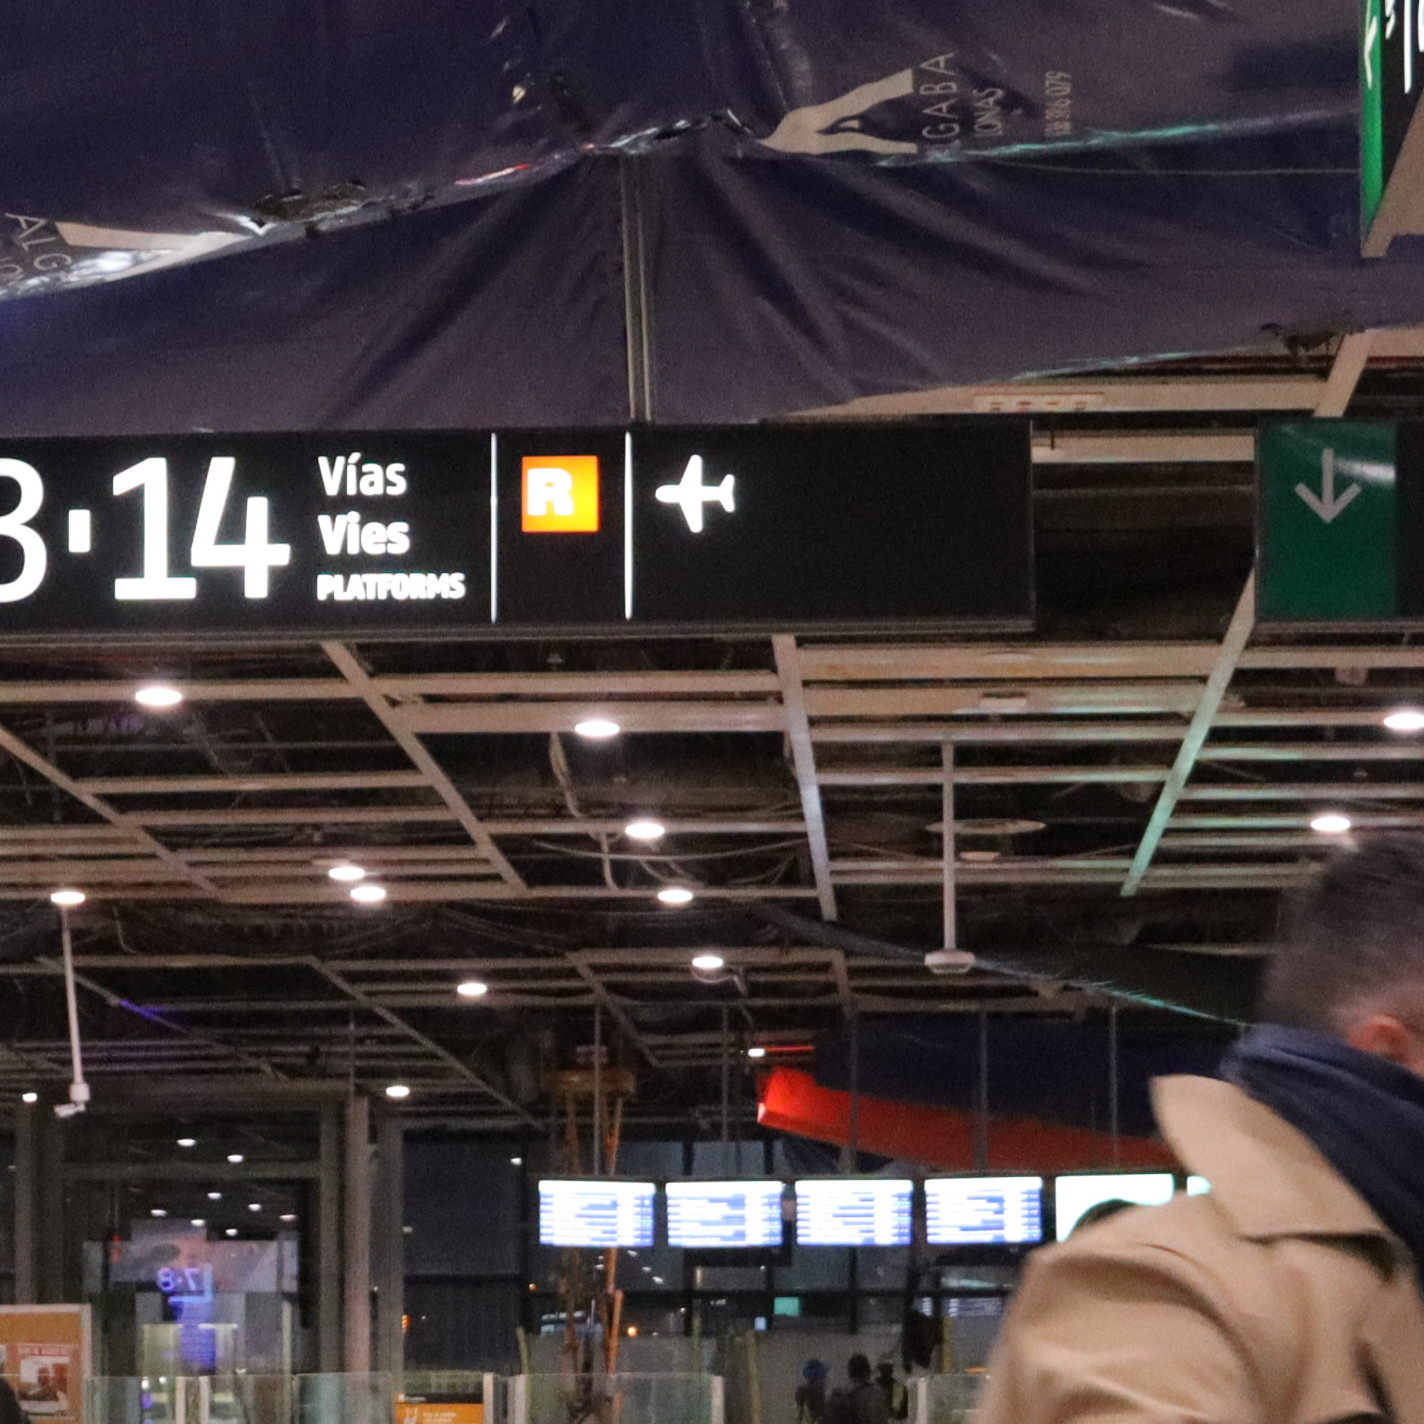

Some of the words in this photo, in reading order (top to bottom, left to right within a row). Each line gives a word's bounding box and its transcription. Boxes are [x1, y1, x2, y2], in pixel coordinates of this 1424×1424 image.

[317, 451, 408, 497] Vías
[526, 467, 575, 517] R
[317, 510, 412, 557] Vies
[316, 571, 466, 603] PLATFORMS
